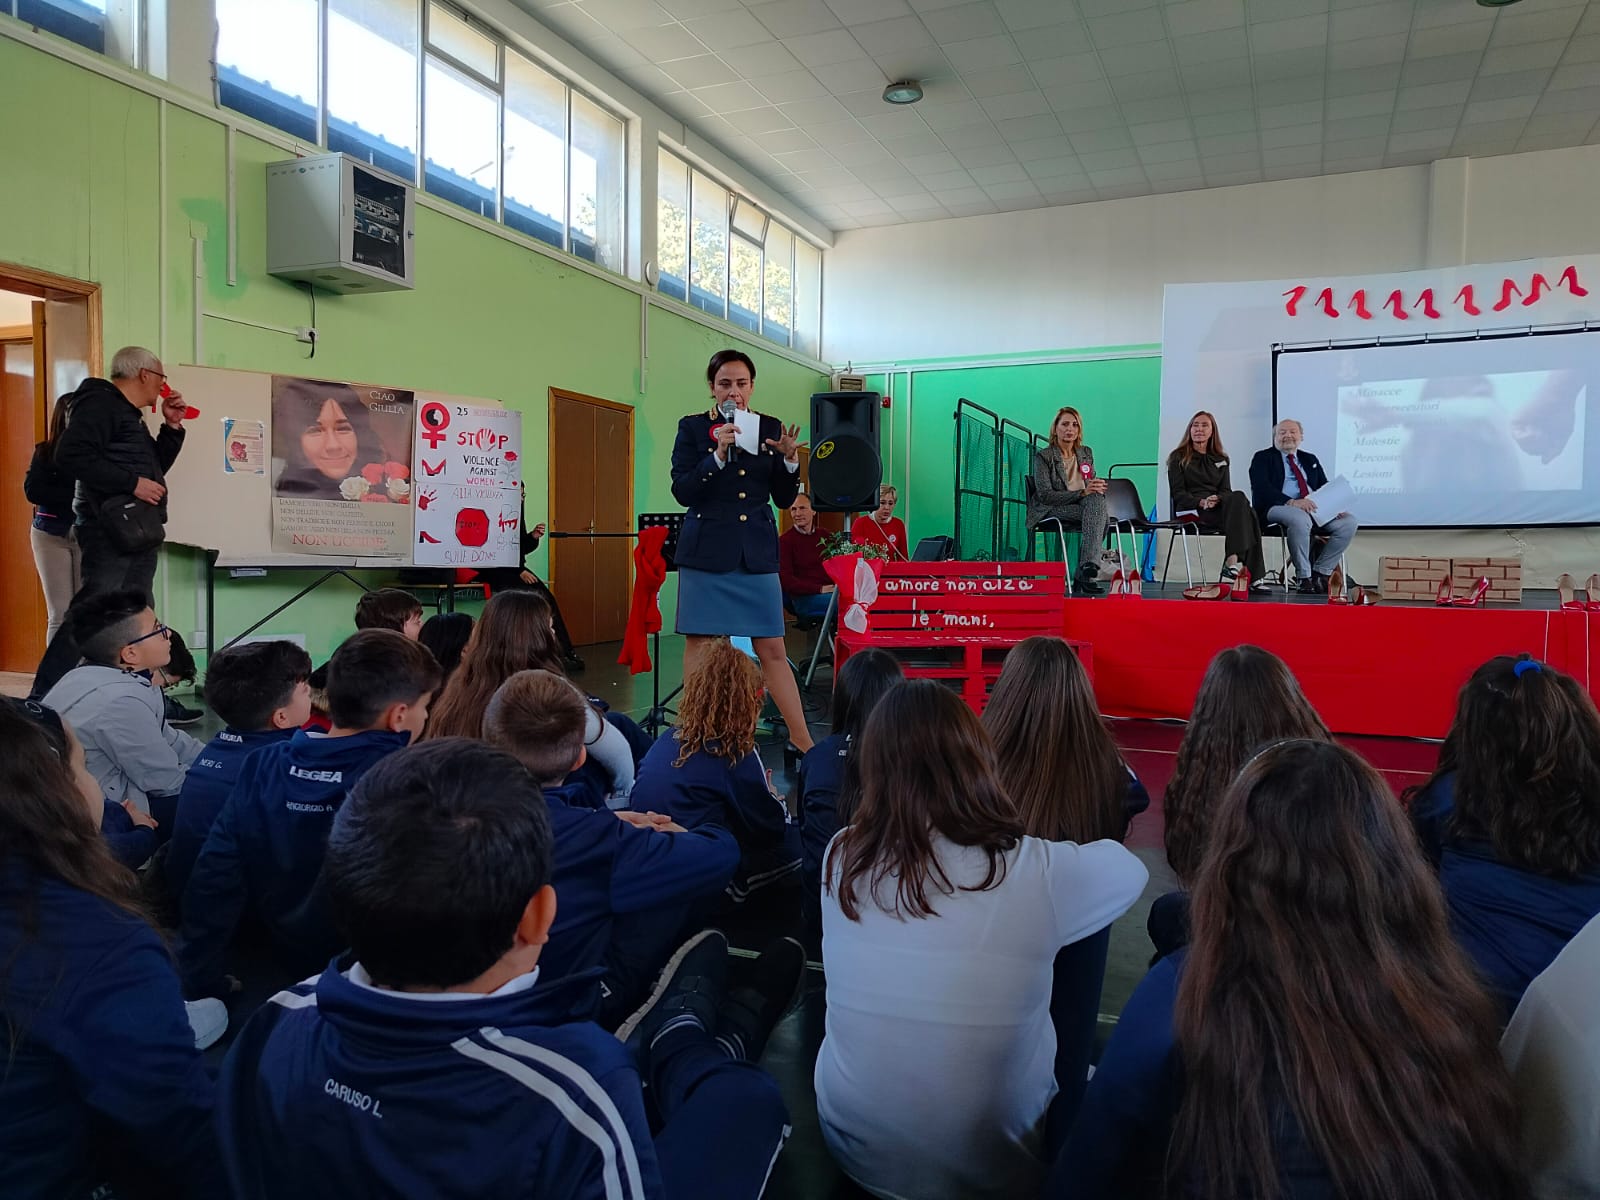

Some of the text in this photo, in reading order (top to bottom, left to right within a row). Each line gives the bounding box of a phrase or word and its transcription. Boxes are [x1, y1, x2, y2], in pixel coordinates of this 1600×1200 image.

[456, 406, 469, 417] 25
[456, 428, 509, 452] STOP
[463, 455, 500, 467] VIOLENCE
[469, 467, 497, 476] AGAINST
[466, 477, 495, 487] WOMEN
[292, 534, 327, 546] NON
[885, 563, 1033, 592] amore non alza
[911, 597, 995, 629] le mani,
[289, 765, 342, 783] LEGEA
[324, 1078, 371, 1111] CARUSO
